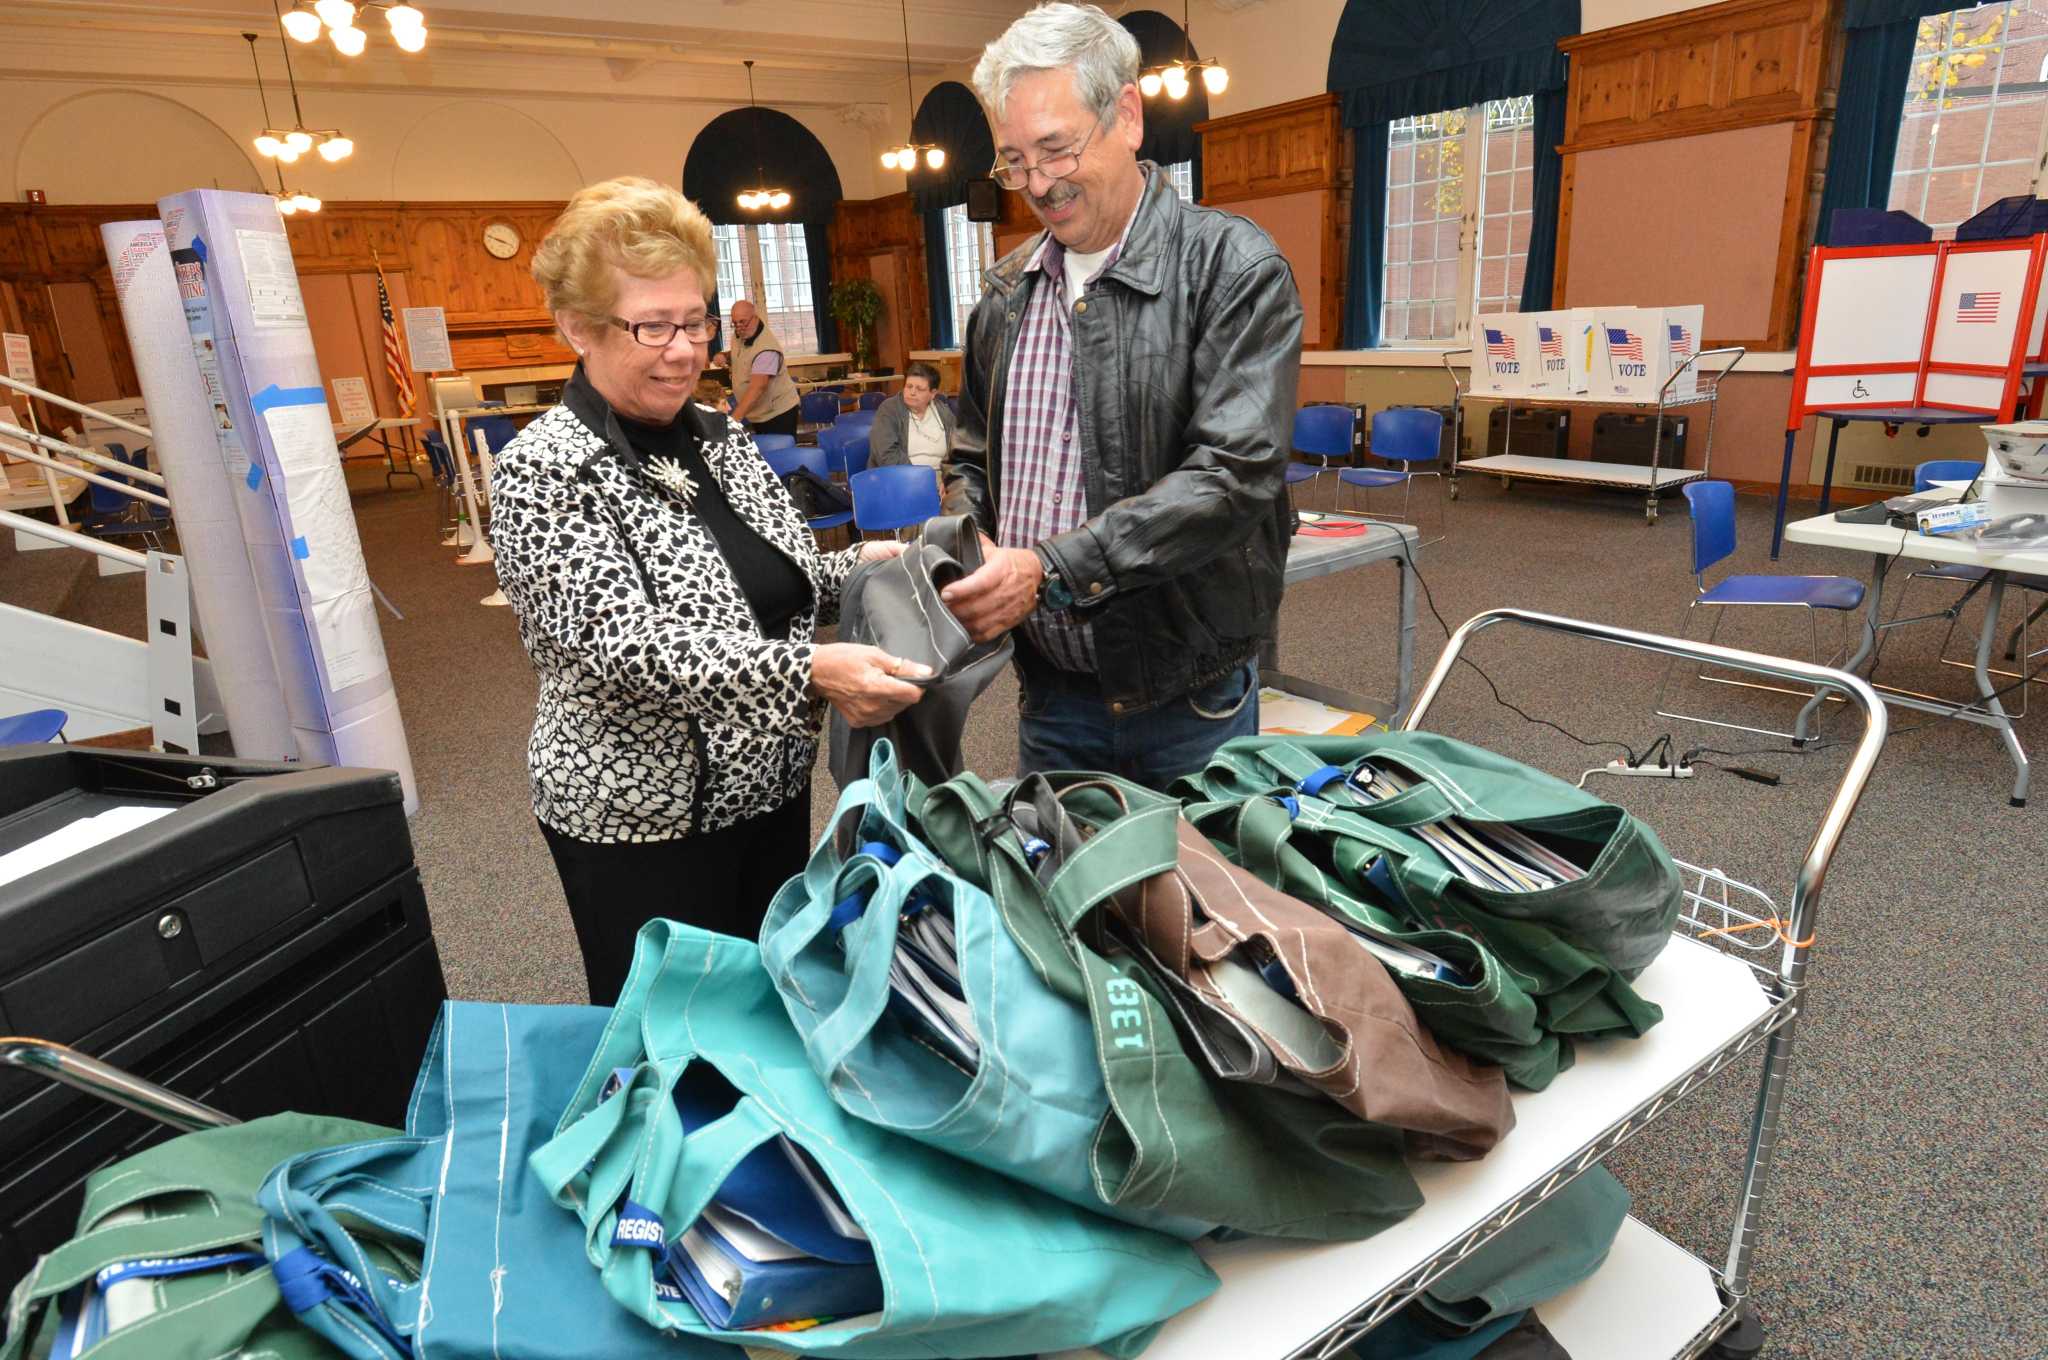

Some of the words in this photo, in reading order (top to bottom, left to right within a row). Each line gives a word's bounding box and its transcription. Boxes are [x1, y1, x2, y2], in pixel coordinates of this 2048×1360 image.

[1495, 361, 1520, 374] VOTE
[1546, 358, 1566, 371] VOTE
[1618, 364, 1647, 377] VOTE
[1106, 965, 1145, 1049] 138
